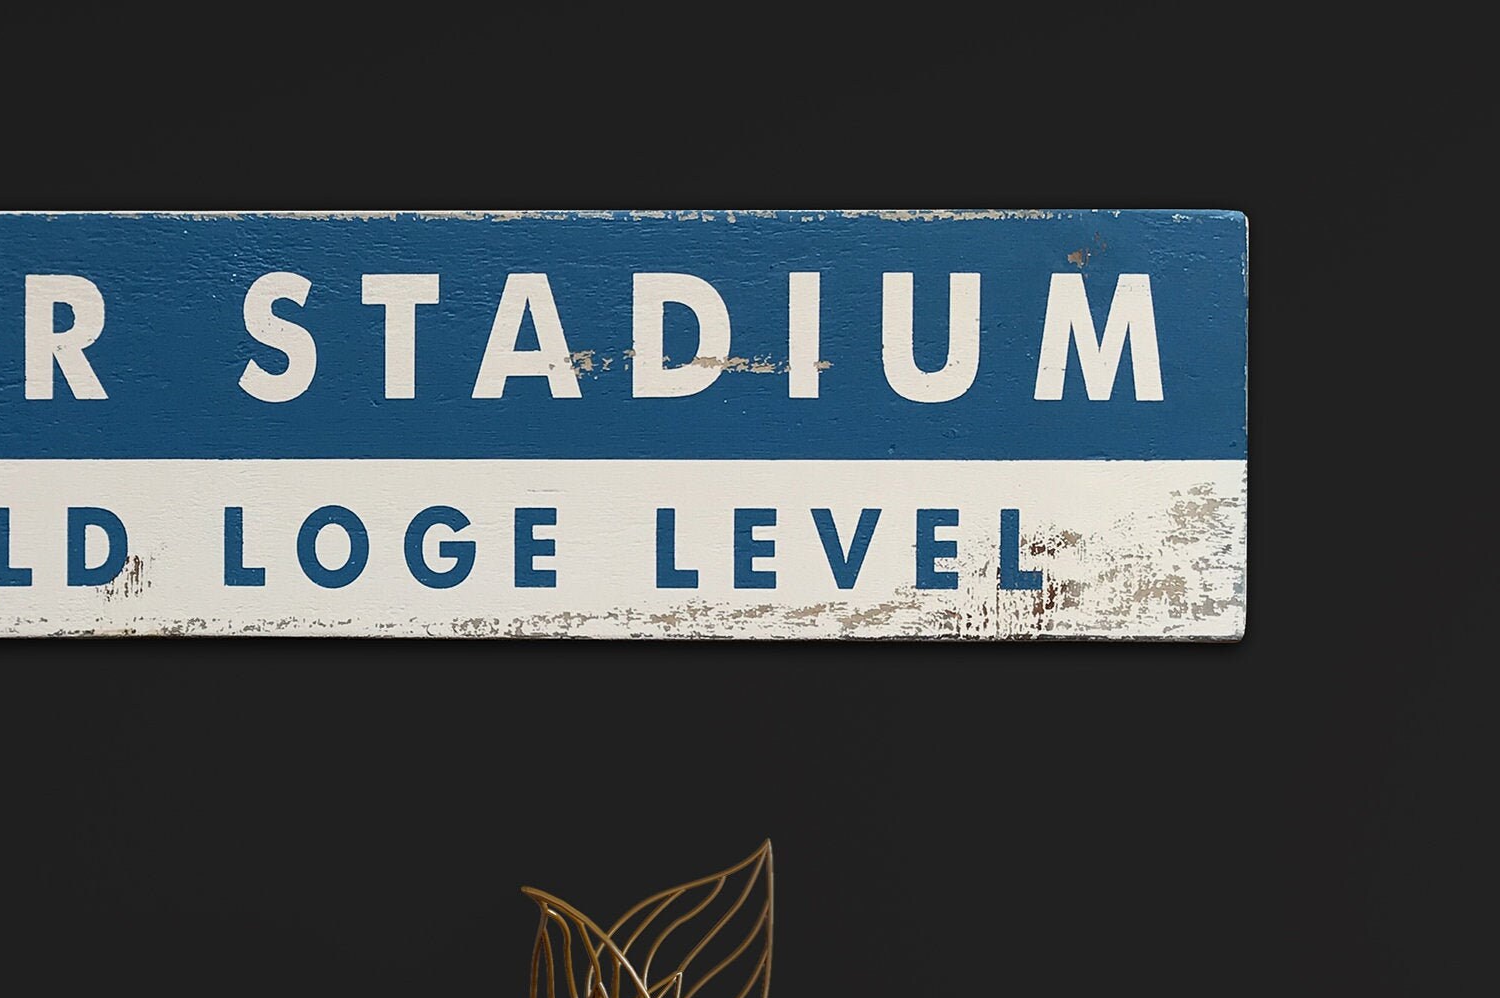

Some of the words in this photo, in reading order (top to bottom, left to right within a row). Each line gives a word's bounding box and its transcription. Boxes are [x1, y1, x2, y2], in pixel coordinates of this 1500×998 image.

[239, 271, 1164, 402] STADIUM
[223, 503, 558, 590] LOGE
[655, 507, 1043, 591] LEVEL
